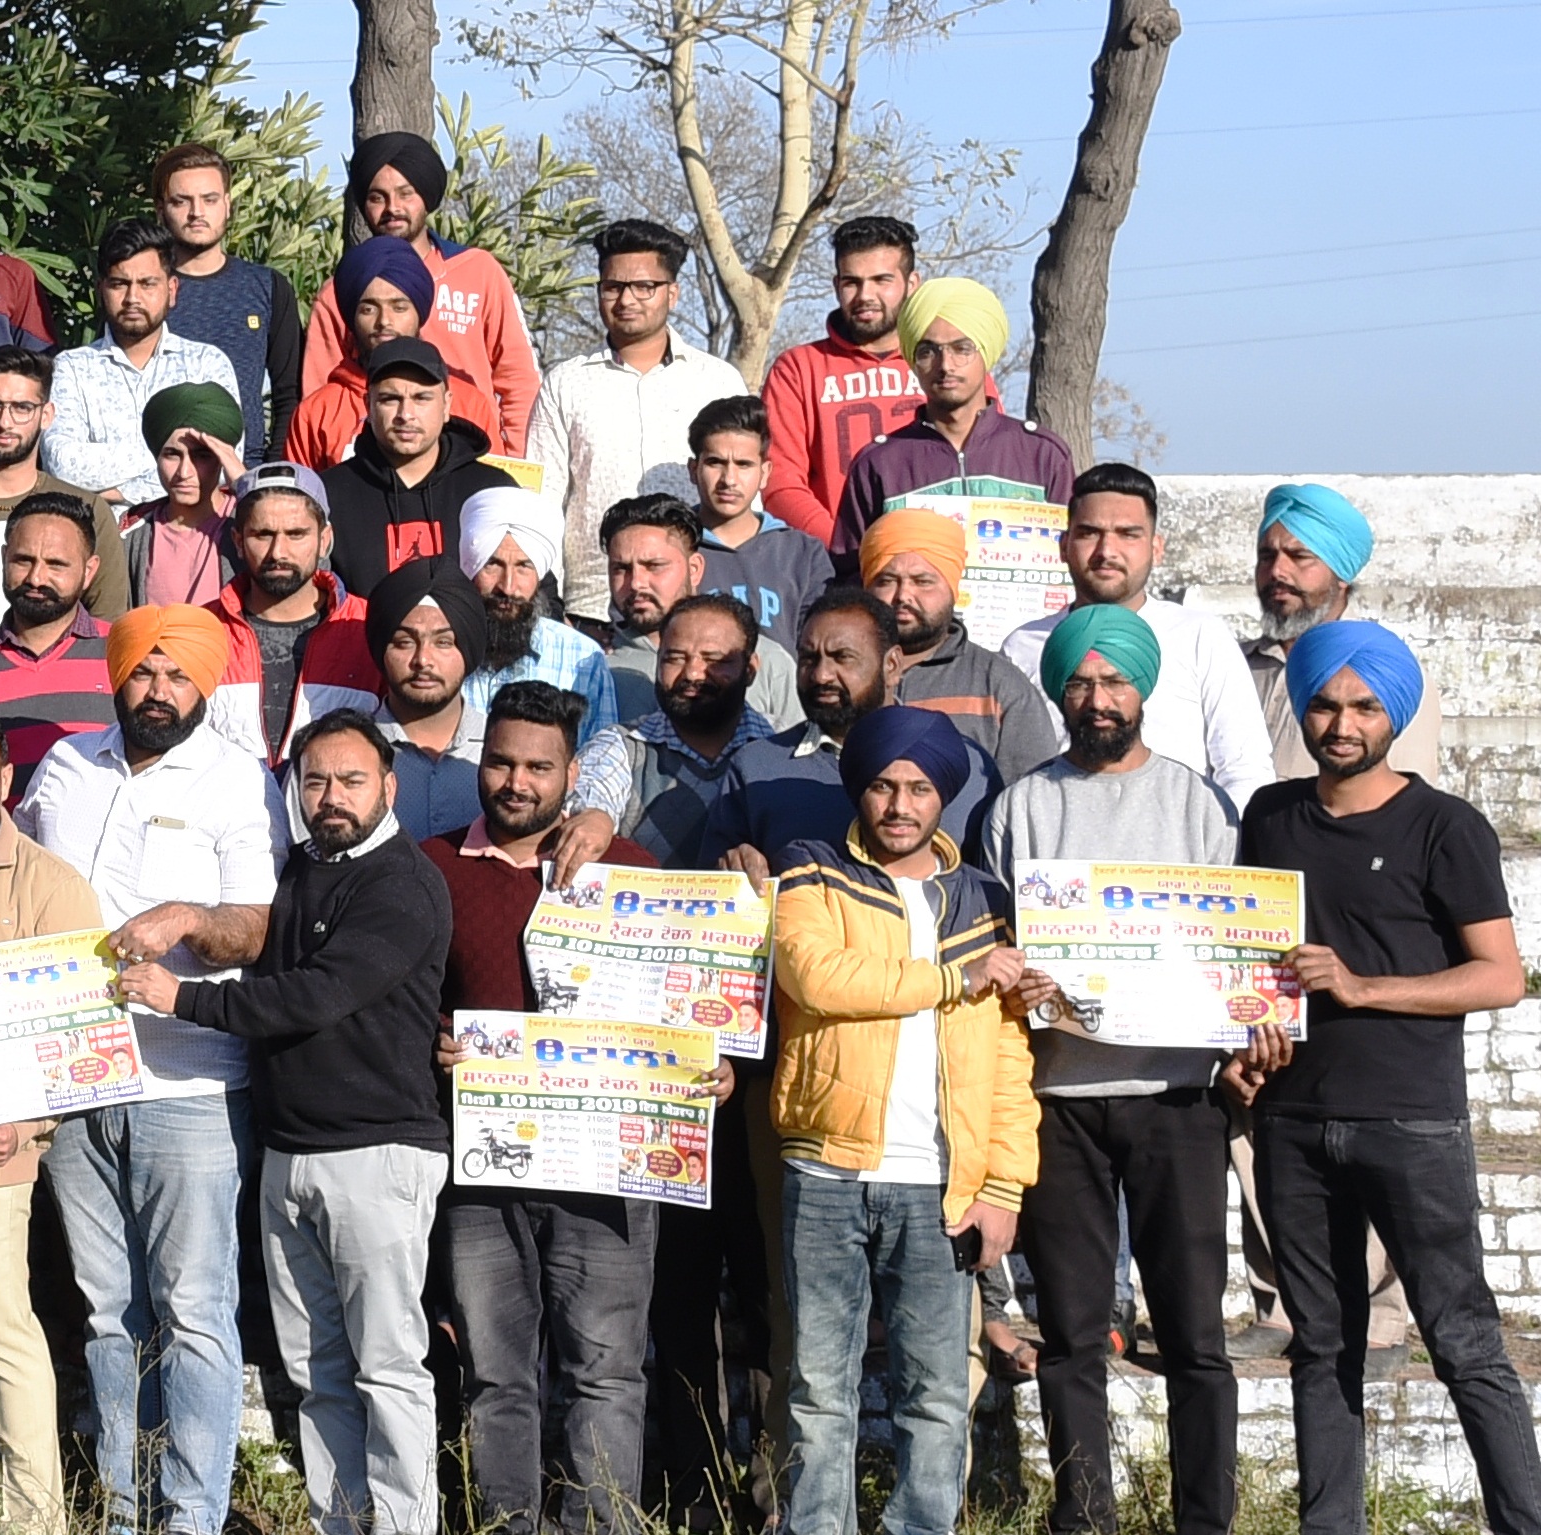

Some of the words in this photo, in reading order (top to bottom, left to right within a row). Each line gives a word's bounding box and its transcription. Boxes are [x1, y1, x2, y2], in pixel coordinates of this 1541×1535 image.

[436, 284, 480, 315] A&F
[820, 366, 926, 404] ADIDA
[1013, 570, 1063, 584] 2019
[566, 937, 591, 951] 10
[594, 943, 638, 959] ਮਾਰਚ
[640, 947, 686, 963] 2019
[1067, 944, 1096, 959] 10
[500, 1094, 527, 1108] 10
[529, 1096, 579, 1110] ਮਾਰਚ
[581, 1097, 637, 1114] 2019
